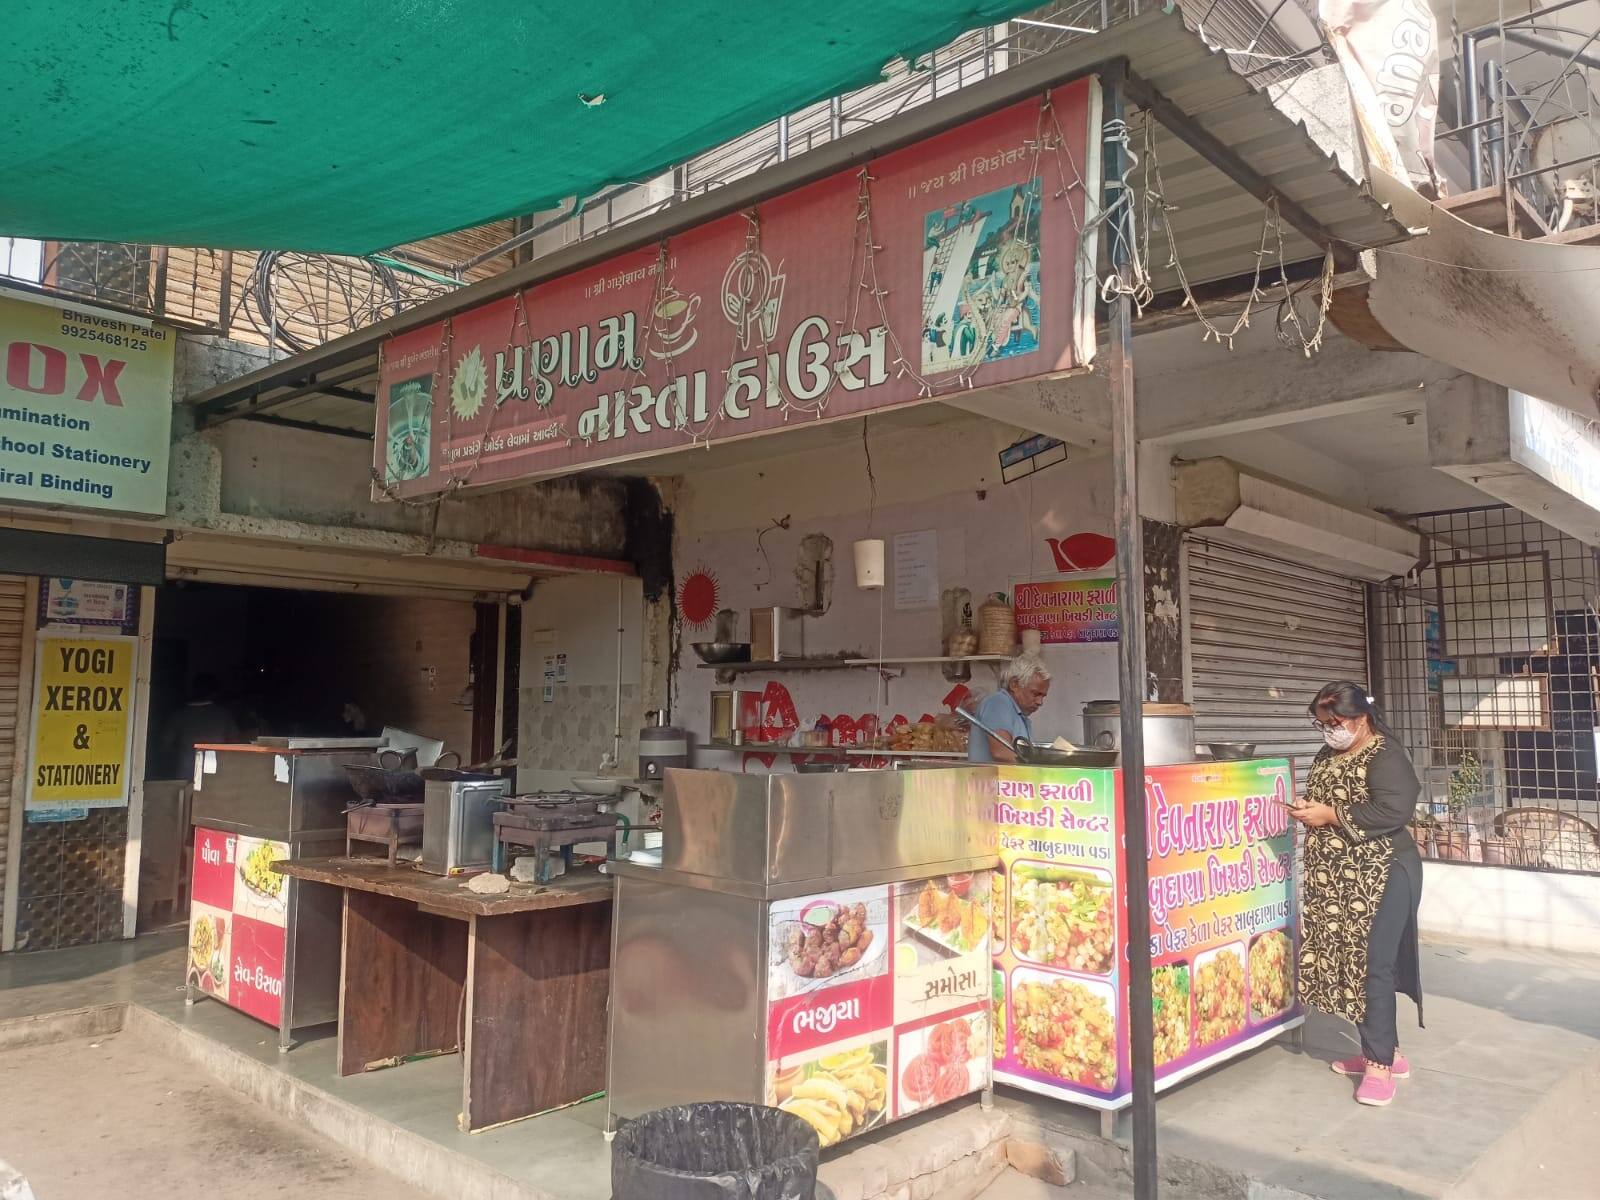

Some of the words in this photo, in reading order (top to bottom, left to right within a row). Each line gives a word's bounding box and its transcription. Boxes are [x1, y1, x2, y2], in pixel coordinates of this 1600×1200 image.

[61, 325, 148, 351] 9925468125
[62, 310, 127, 333] Bhavesh
[131, 324, 166, 341] Patel
[494, 311, 644, 406] પ્રણામ
[723, 315, 890, 420] હાઉસ
[0, 406, 90, 431] mination
[0, 436, 45, 457] hool
[51, 442, 151, 473] Stationery
[40, 474, 113, 499] Binding
[60, 647, 115, 674] YOGI
[44, 685, 124, 712] XEROX
[73, 723, 90, 750] &
[37, 763, 121, 787] STATIONERY
[1039, 778, 1093, 802] ફરાળી
[999, 802, 1055, 828] ખિચડી
[1059, 806, 1110, 833] સેન્ટર
[1027, 838, 1086, 859] સાબુદાણા
[1087, 845, 1112, 860] વડા
[1207, 848, 1256, 900] ખિચડી
[1256, 846, 1293, 887] સેન્ટર
[1189, 917, 1211, 945] કેળા
[1212, 911, 1234, 938] વેફર
[1234, 905, 1276, 936] સાબુદાણા
[1277, 900, 1292, 918] વડા
[924, 966, 977, 1000] સમોસા
[792, 997, 860, 1034] ભજીયા
